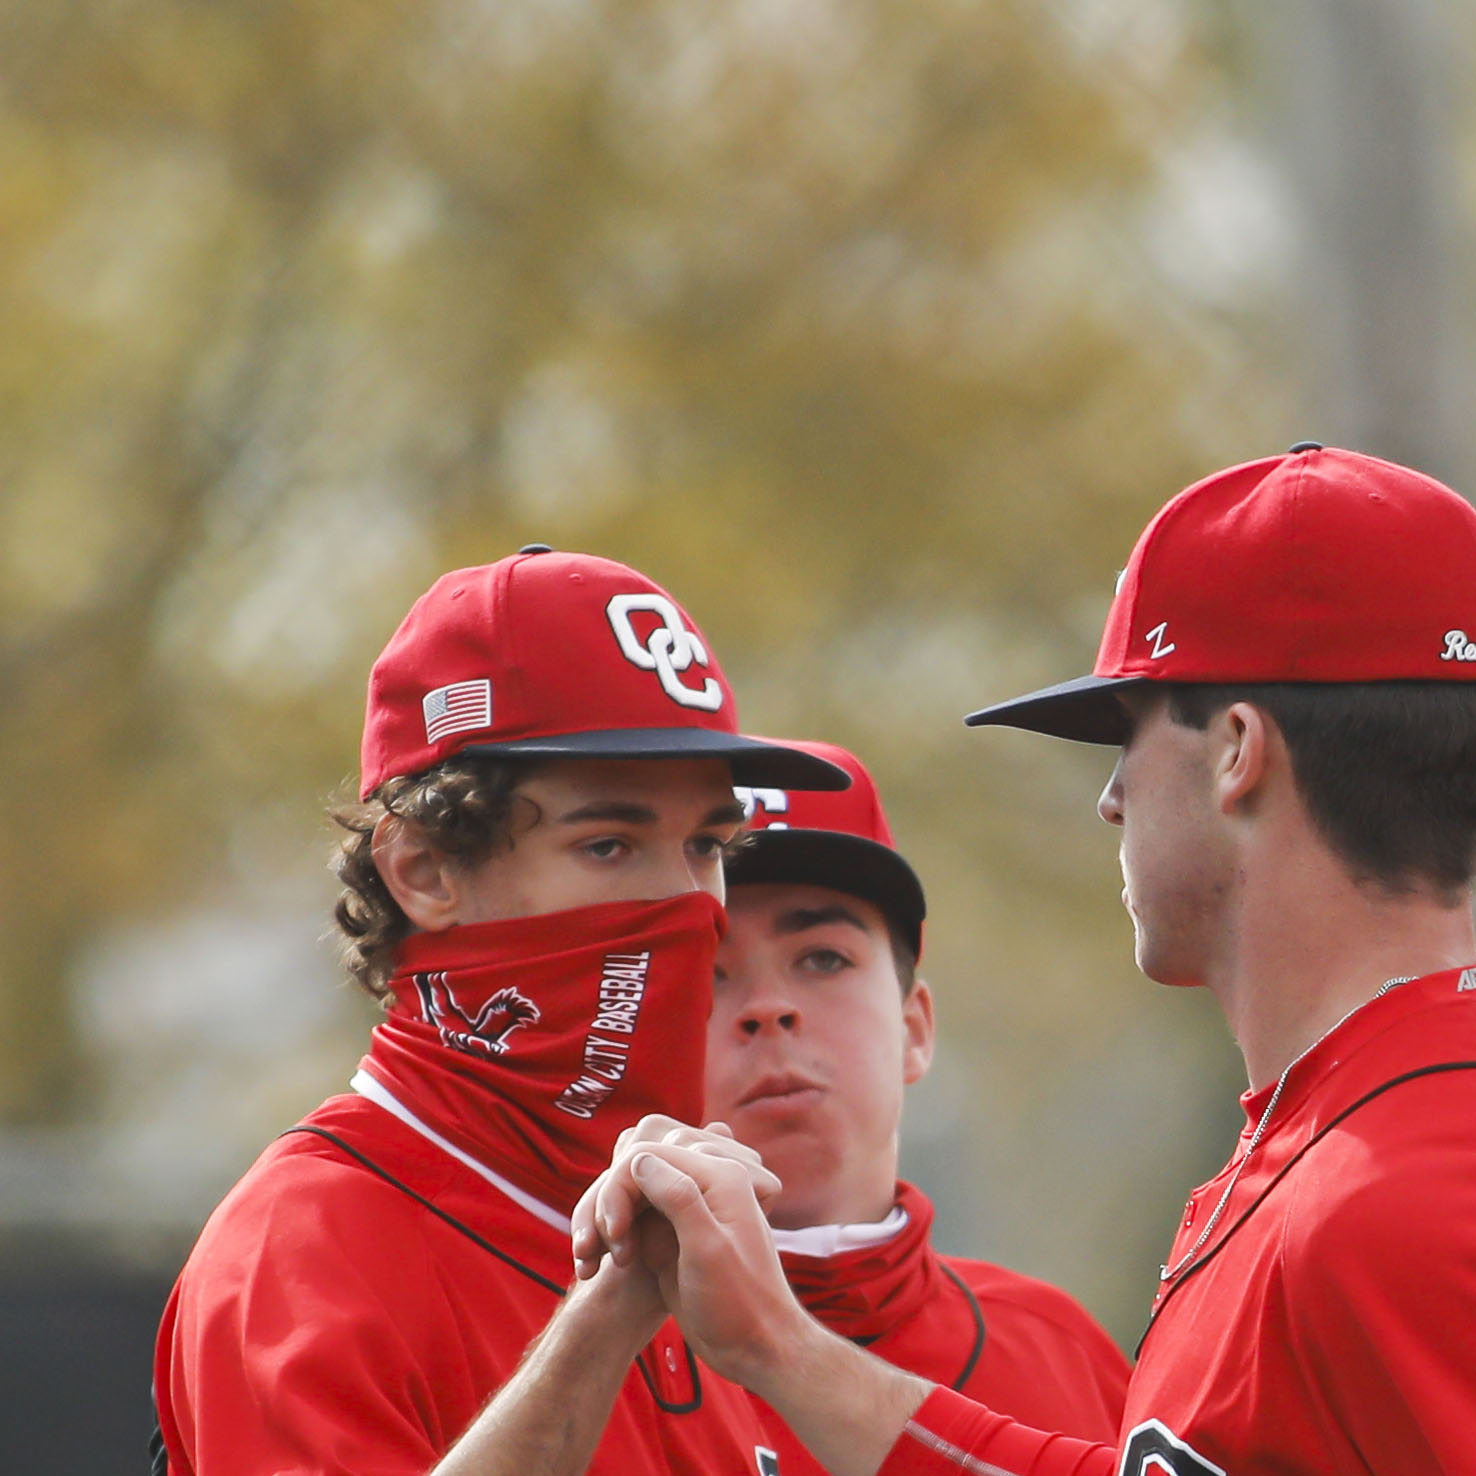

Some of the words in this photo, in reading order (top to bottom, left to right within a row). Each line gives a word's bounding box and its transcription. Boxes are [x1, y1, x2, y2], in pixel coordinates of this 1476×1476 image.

[605, 593, 724, 712] OC
[1145, 621, 1176, 659] Z
[591, 951, 651, 1034] BASEBALL
[584, 1034, 630, 1080] CITY
